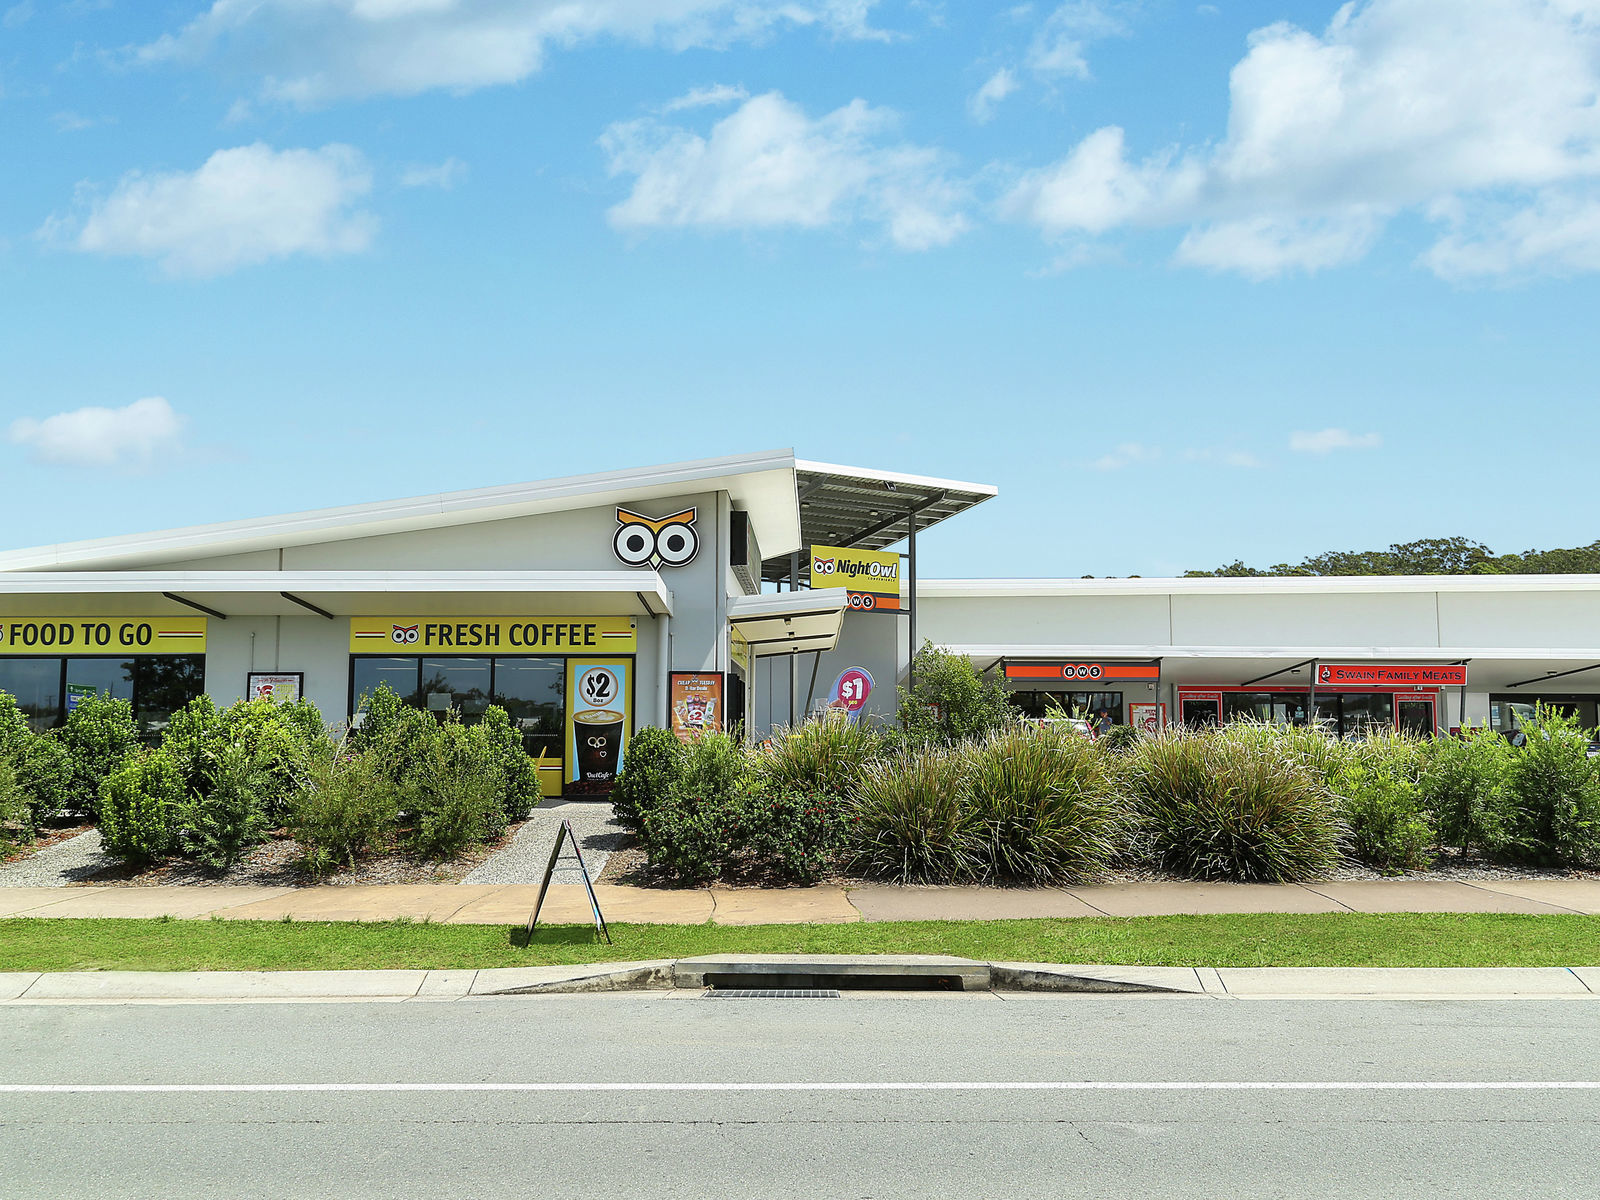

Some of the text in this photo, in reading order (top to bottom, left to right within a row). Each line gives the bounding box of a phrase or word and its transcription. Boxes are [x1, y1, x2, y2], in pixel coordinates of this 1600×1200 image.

[836, 559, 898, 578] NightOwl
[9, 623, 153, 646] FOOD TO GO
[424, 623, 597, 646] FRESH COFFEE
[1065, 667, 1100, 677] BWS
[586, 672, 611, 698] $2
[841, 677, 863, 700] $1
